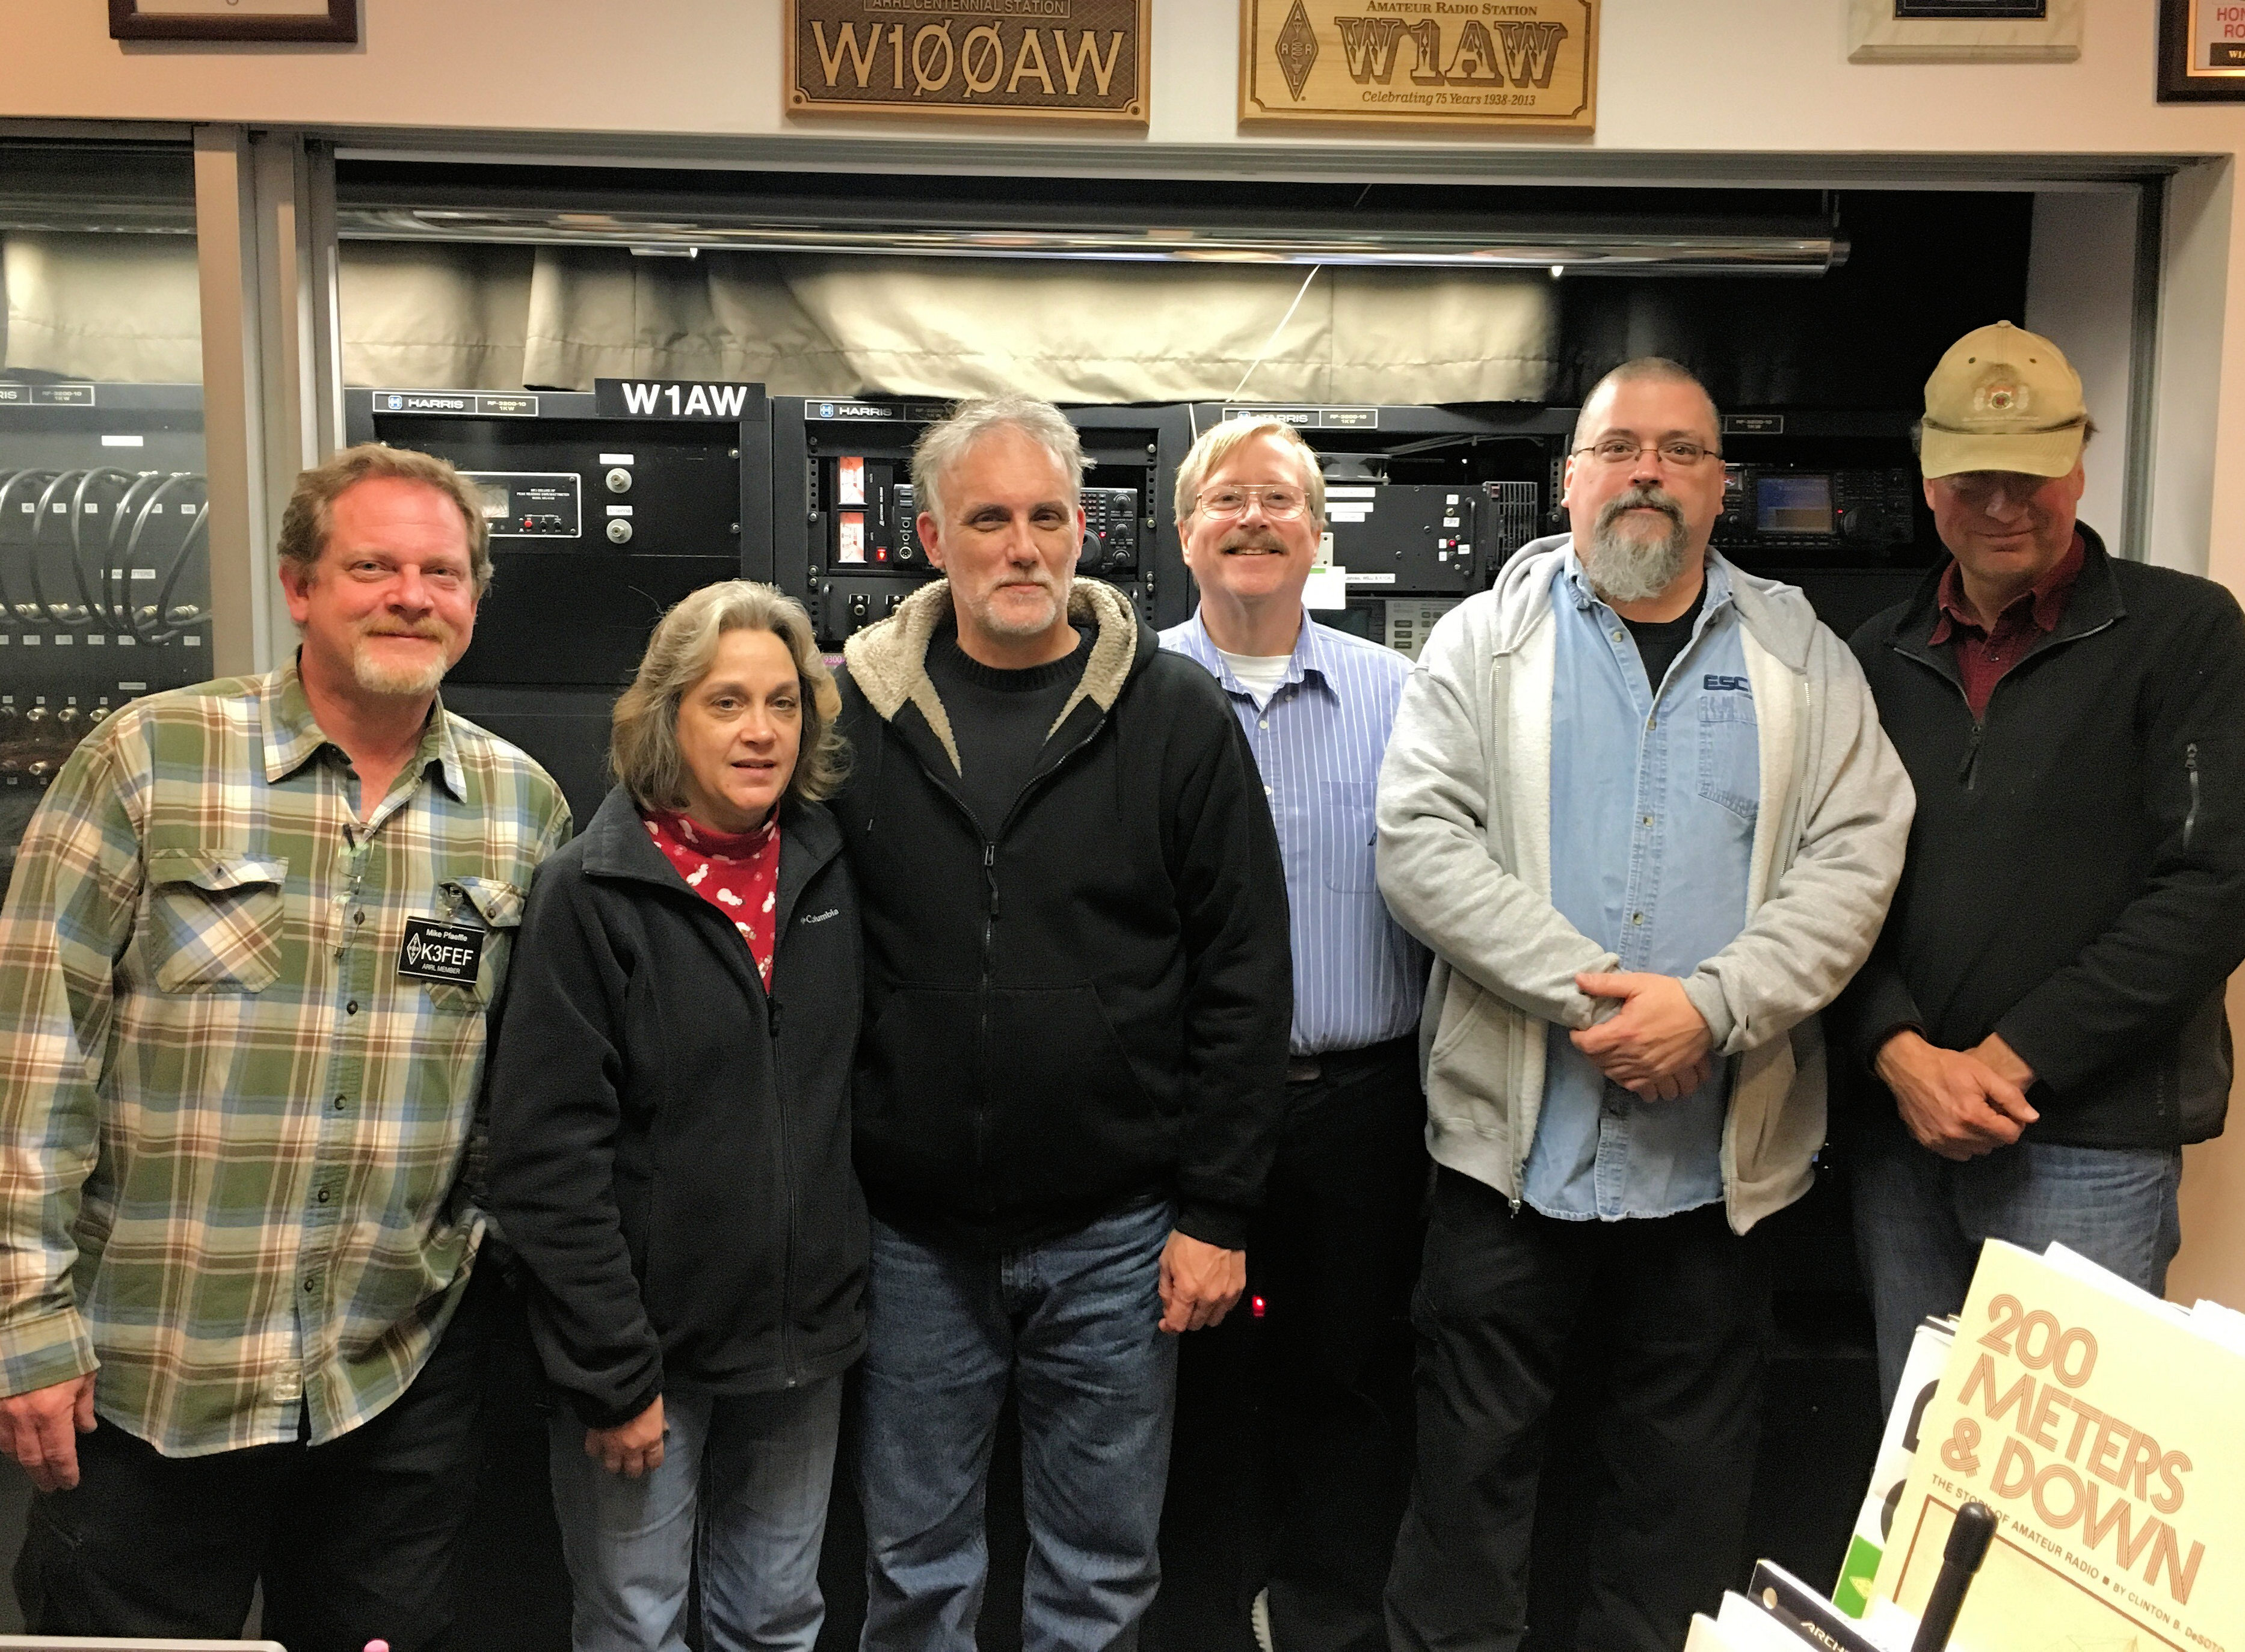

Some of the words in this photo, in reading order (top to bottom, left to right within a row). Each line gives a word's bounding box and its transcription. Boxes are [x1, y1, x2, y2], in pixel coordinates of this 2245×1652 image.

[919, 0, 1001, 11] CENTENNIAL
[1005, 0, 1064, 13] STATION
[1334, 17, 1568, 88] W1AW
[1363, 91, 1433, 105] Celebrating
[1436, 93, 1447, 103] 75
[1450, 93, 1481, 105] Years
[1484, 94, 1536, 106] 1938-2013
[408, 399, 464, 409] HARRIS
[621, 383, 747, 416] W1AW
[839, 407, 893, 416] HARRIS
[421, 942, 473, 966] K3FEF
[1977, 1294, 2098, 1388] 200
[1957, 1352, 2193, 1514] METERS
[1941, 1417, 1981, 1478] &
[1990, 1436, 2205, 1606] DOWN
[1932, 1473, 1954, 1493] THE
[1995, 1509, 2010, 1523] OF
[2012, 1521, 2063, 1558] AMATEUR
[2065, 1552, 2099, 1579] RADIO
[2113, 1582, 2126, 1595] BY
[2128, 1592, 2171, 1624] CLINTON
